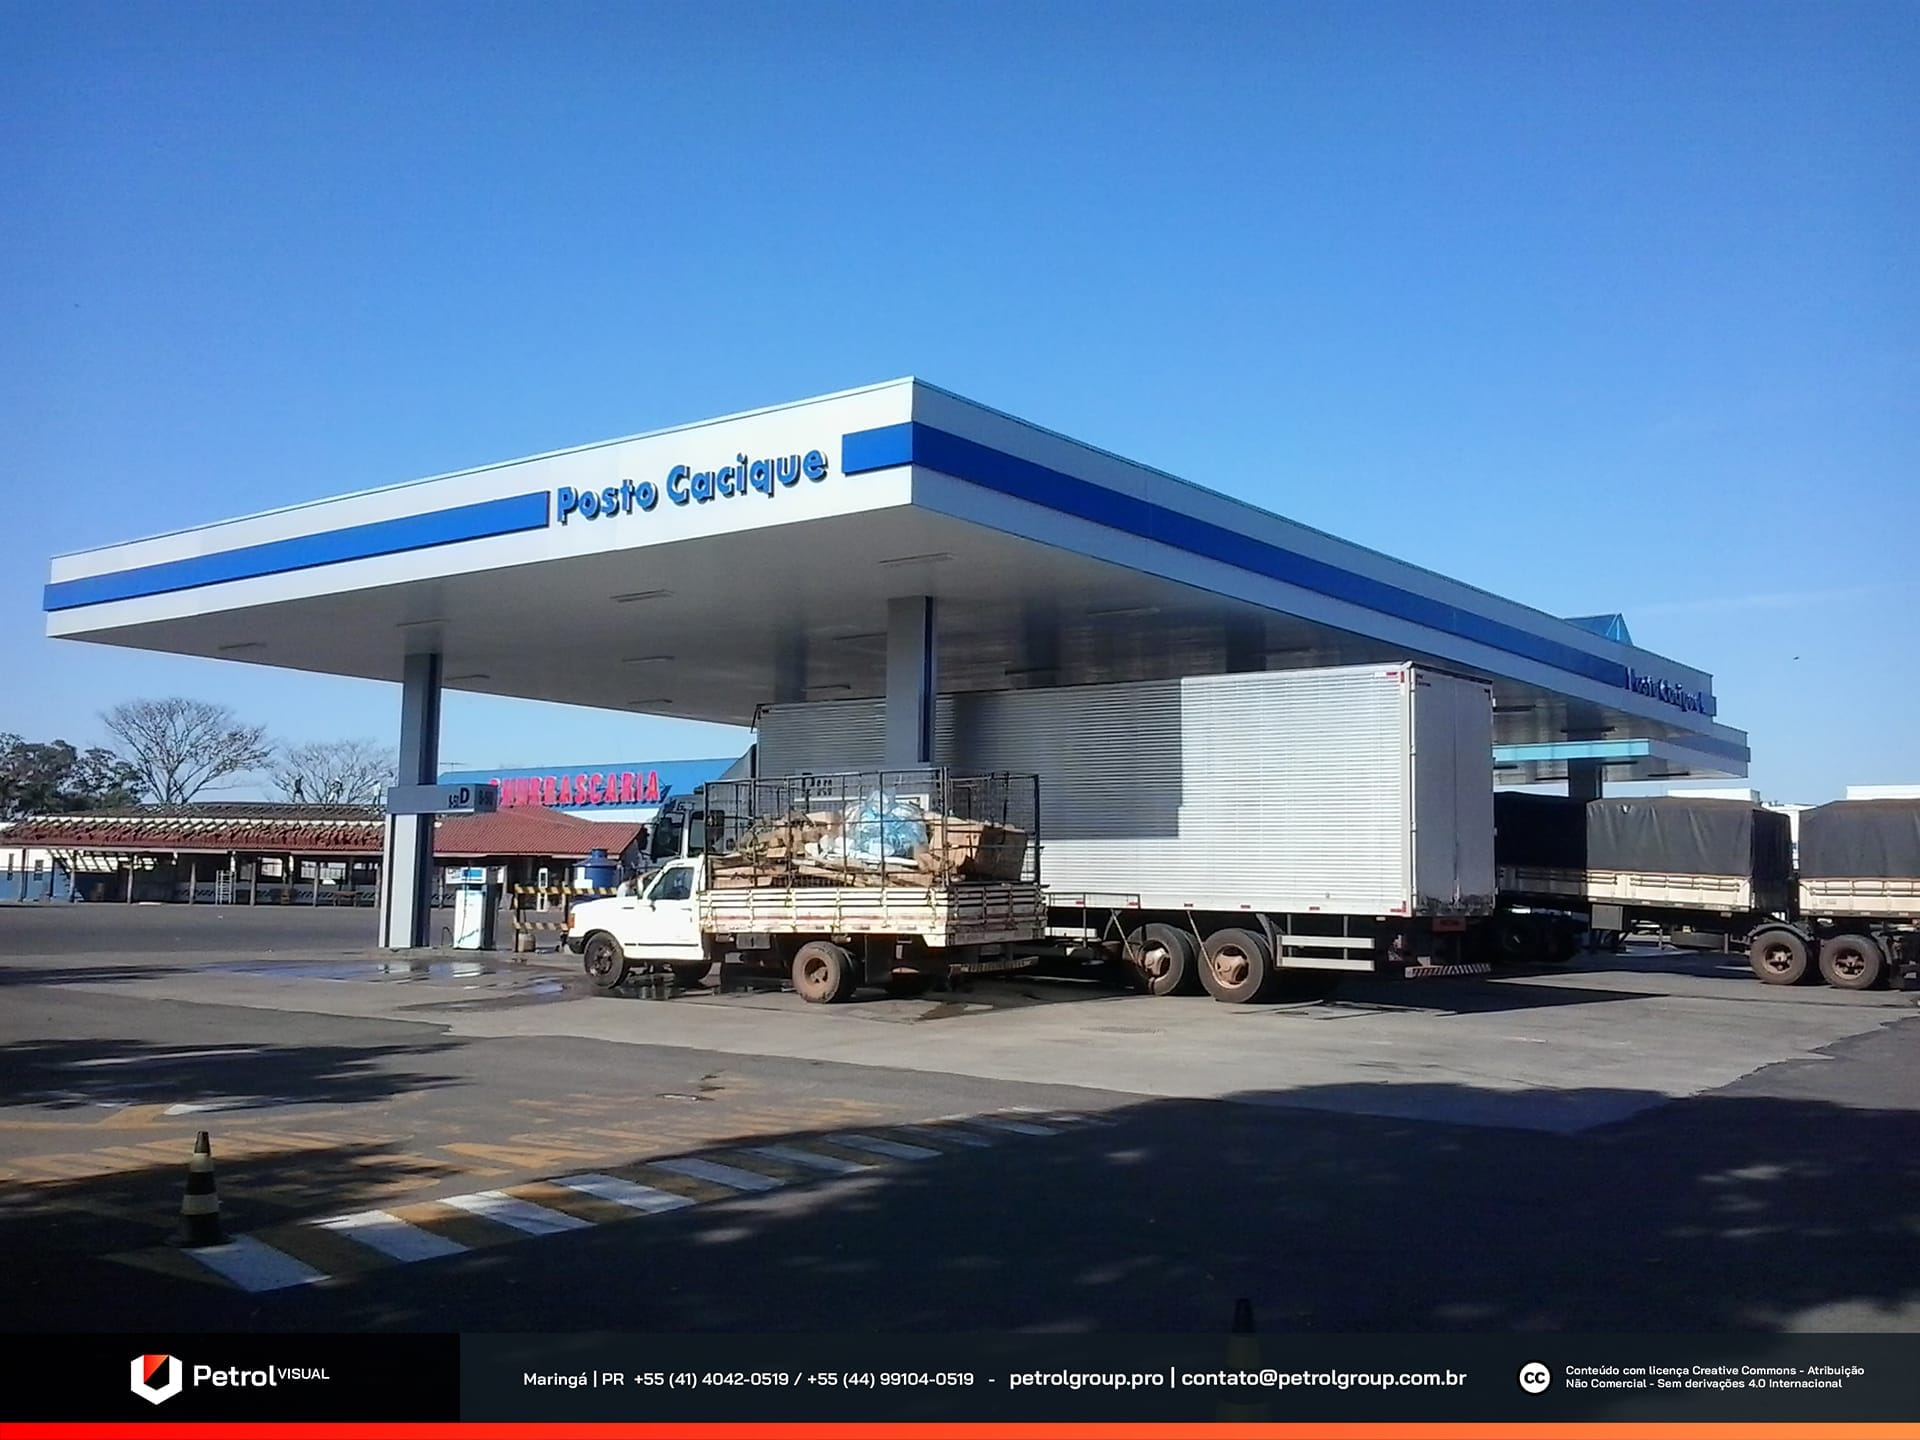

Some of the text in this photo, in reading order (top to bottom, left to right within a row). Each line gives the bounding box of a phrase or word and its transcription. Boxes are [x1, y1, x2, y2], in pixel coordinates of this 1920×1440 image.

[557, 449, 828, 526] Posto Cacique
[489, 771, 659, 806] HURRASCARIA
